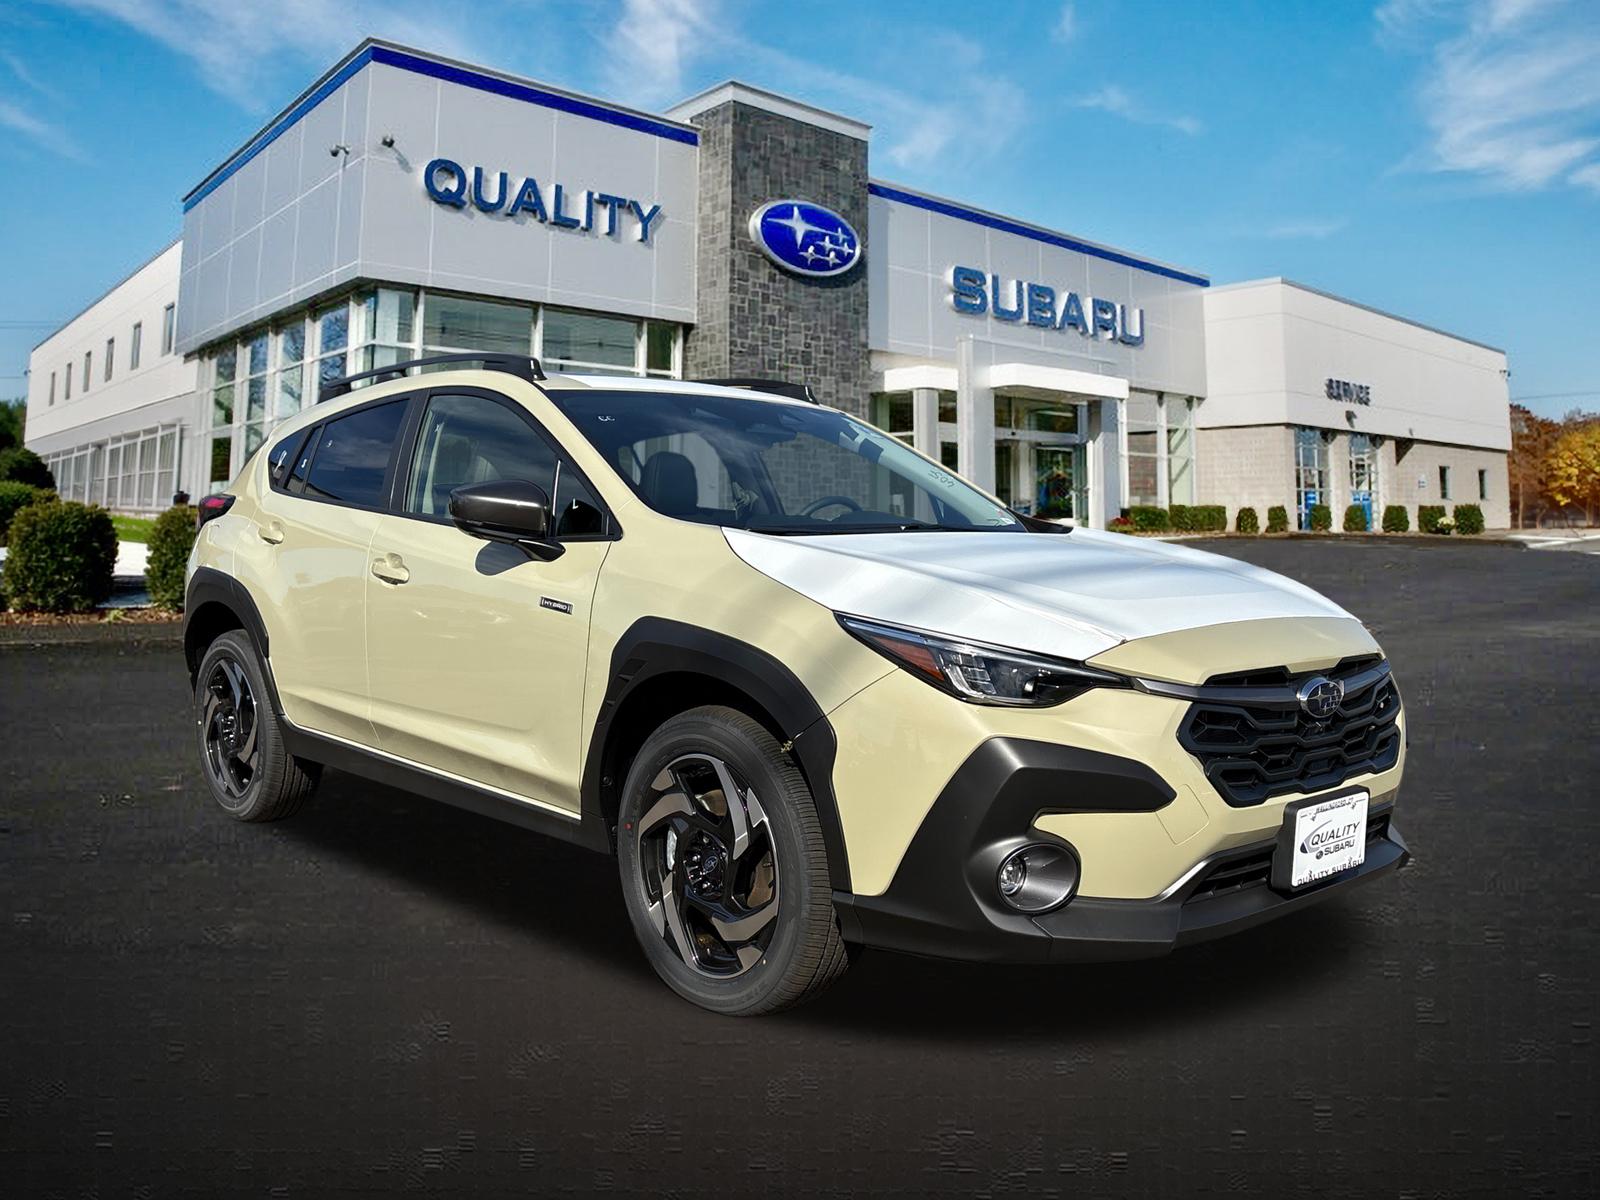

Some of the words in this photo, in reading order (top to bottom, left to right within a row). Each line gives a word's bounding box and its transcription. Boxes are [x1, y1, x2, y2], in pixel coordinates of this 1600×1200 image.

[423, 158, 661, 243] QUALITY
[951, 265, 1145, 347] SUBARU
[1325, 378, 1371, 406] SERVICE
[544, 600, 567, 610] HYBRID
[1311, 822, 1360, 846] QUALITY
[1324, 839, 1355, 856] SUBARU
